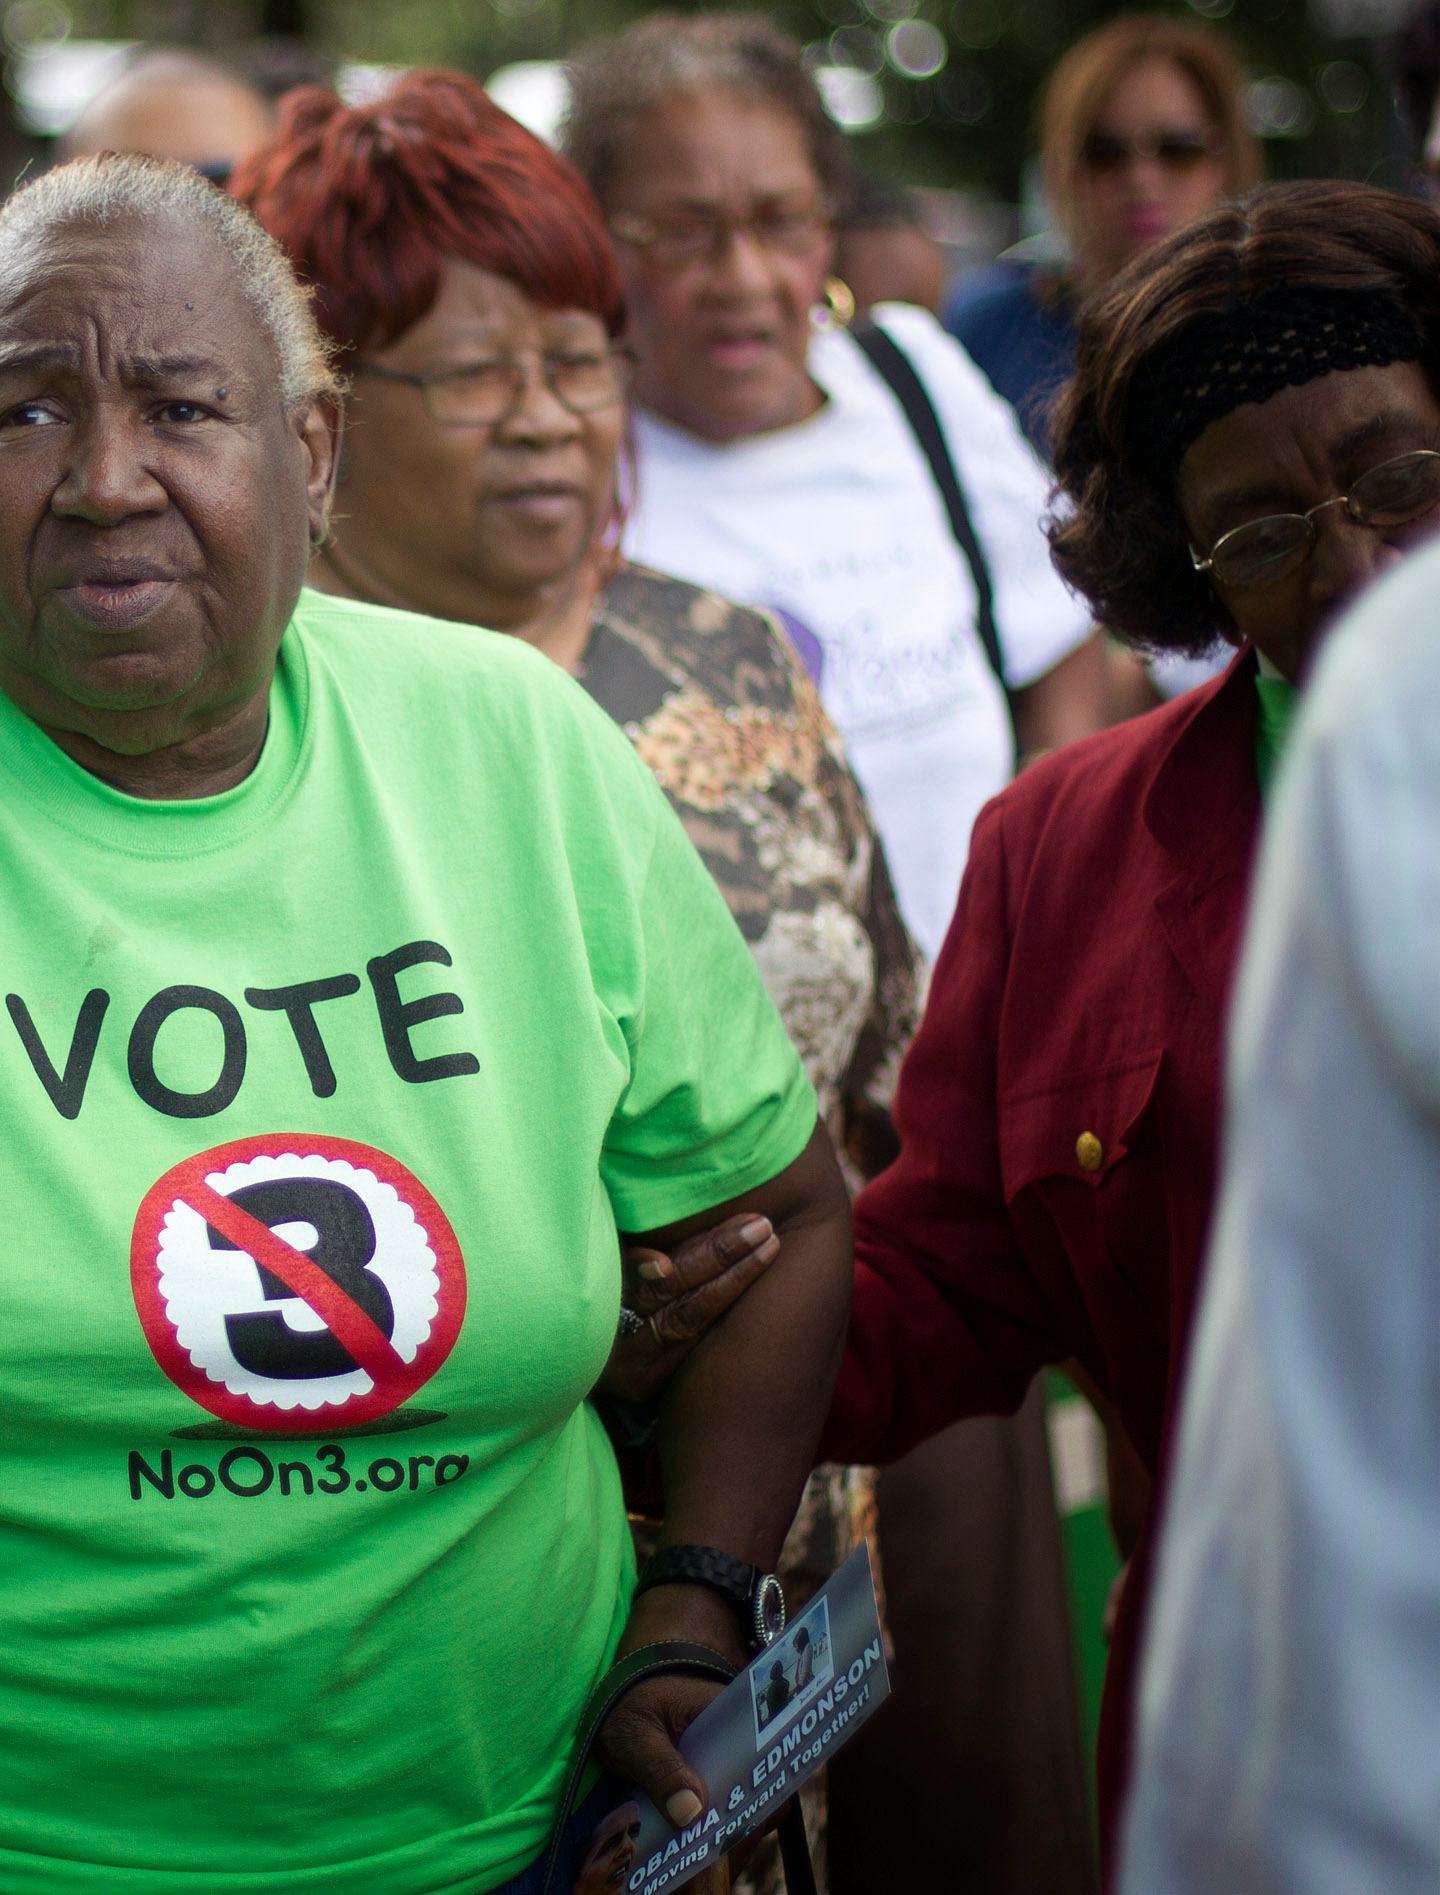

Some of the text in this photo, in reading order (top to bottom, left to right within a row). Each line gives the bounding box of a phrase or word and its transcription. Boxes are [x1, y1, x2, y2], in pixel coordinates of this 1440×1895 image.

[5, 940, 480, 1120] VOTE
[206, 1177, 395, 1380] 3
[128, 1444, 470, 1500] NoOn3.org
[628, 1638, 881, 1891] OBAMA & EDMONSON
[643, 1843, 708, 1895] Moving
[715, 1770, 786, 1846] Forward
[790, 1685, 870, 1773] Together!
